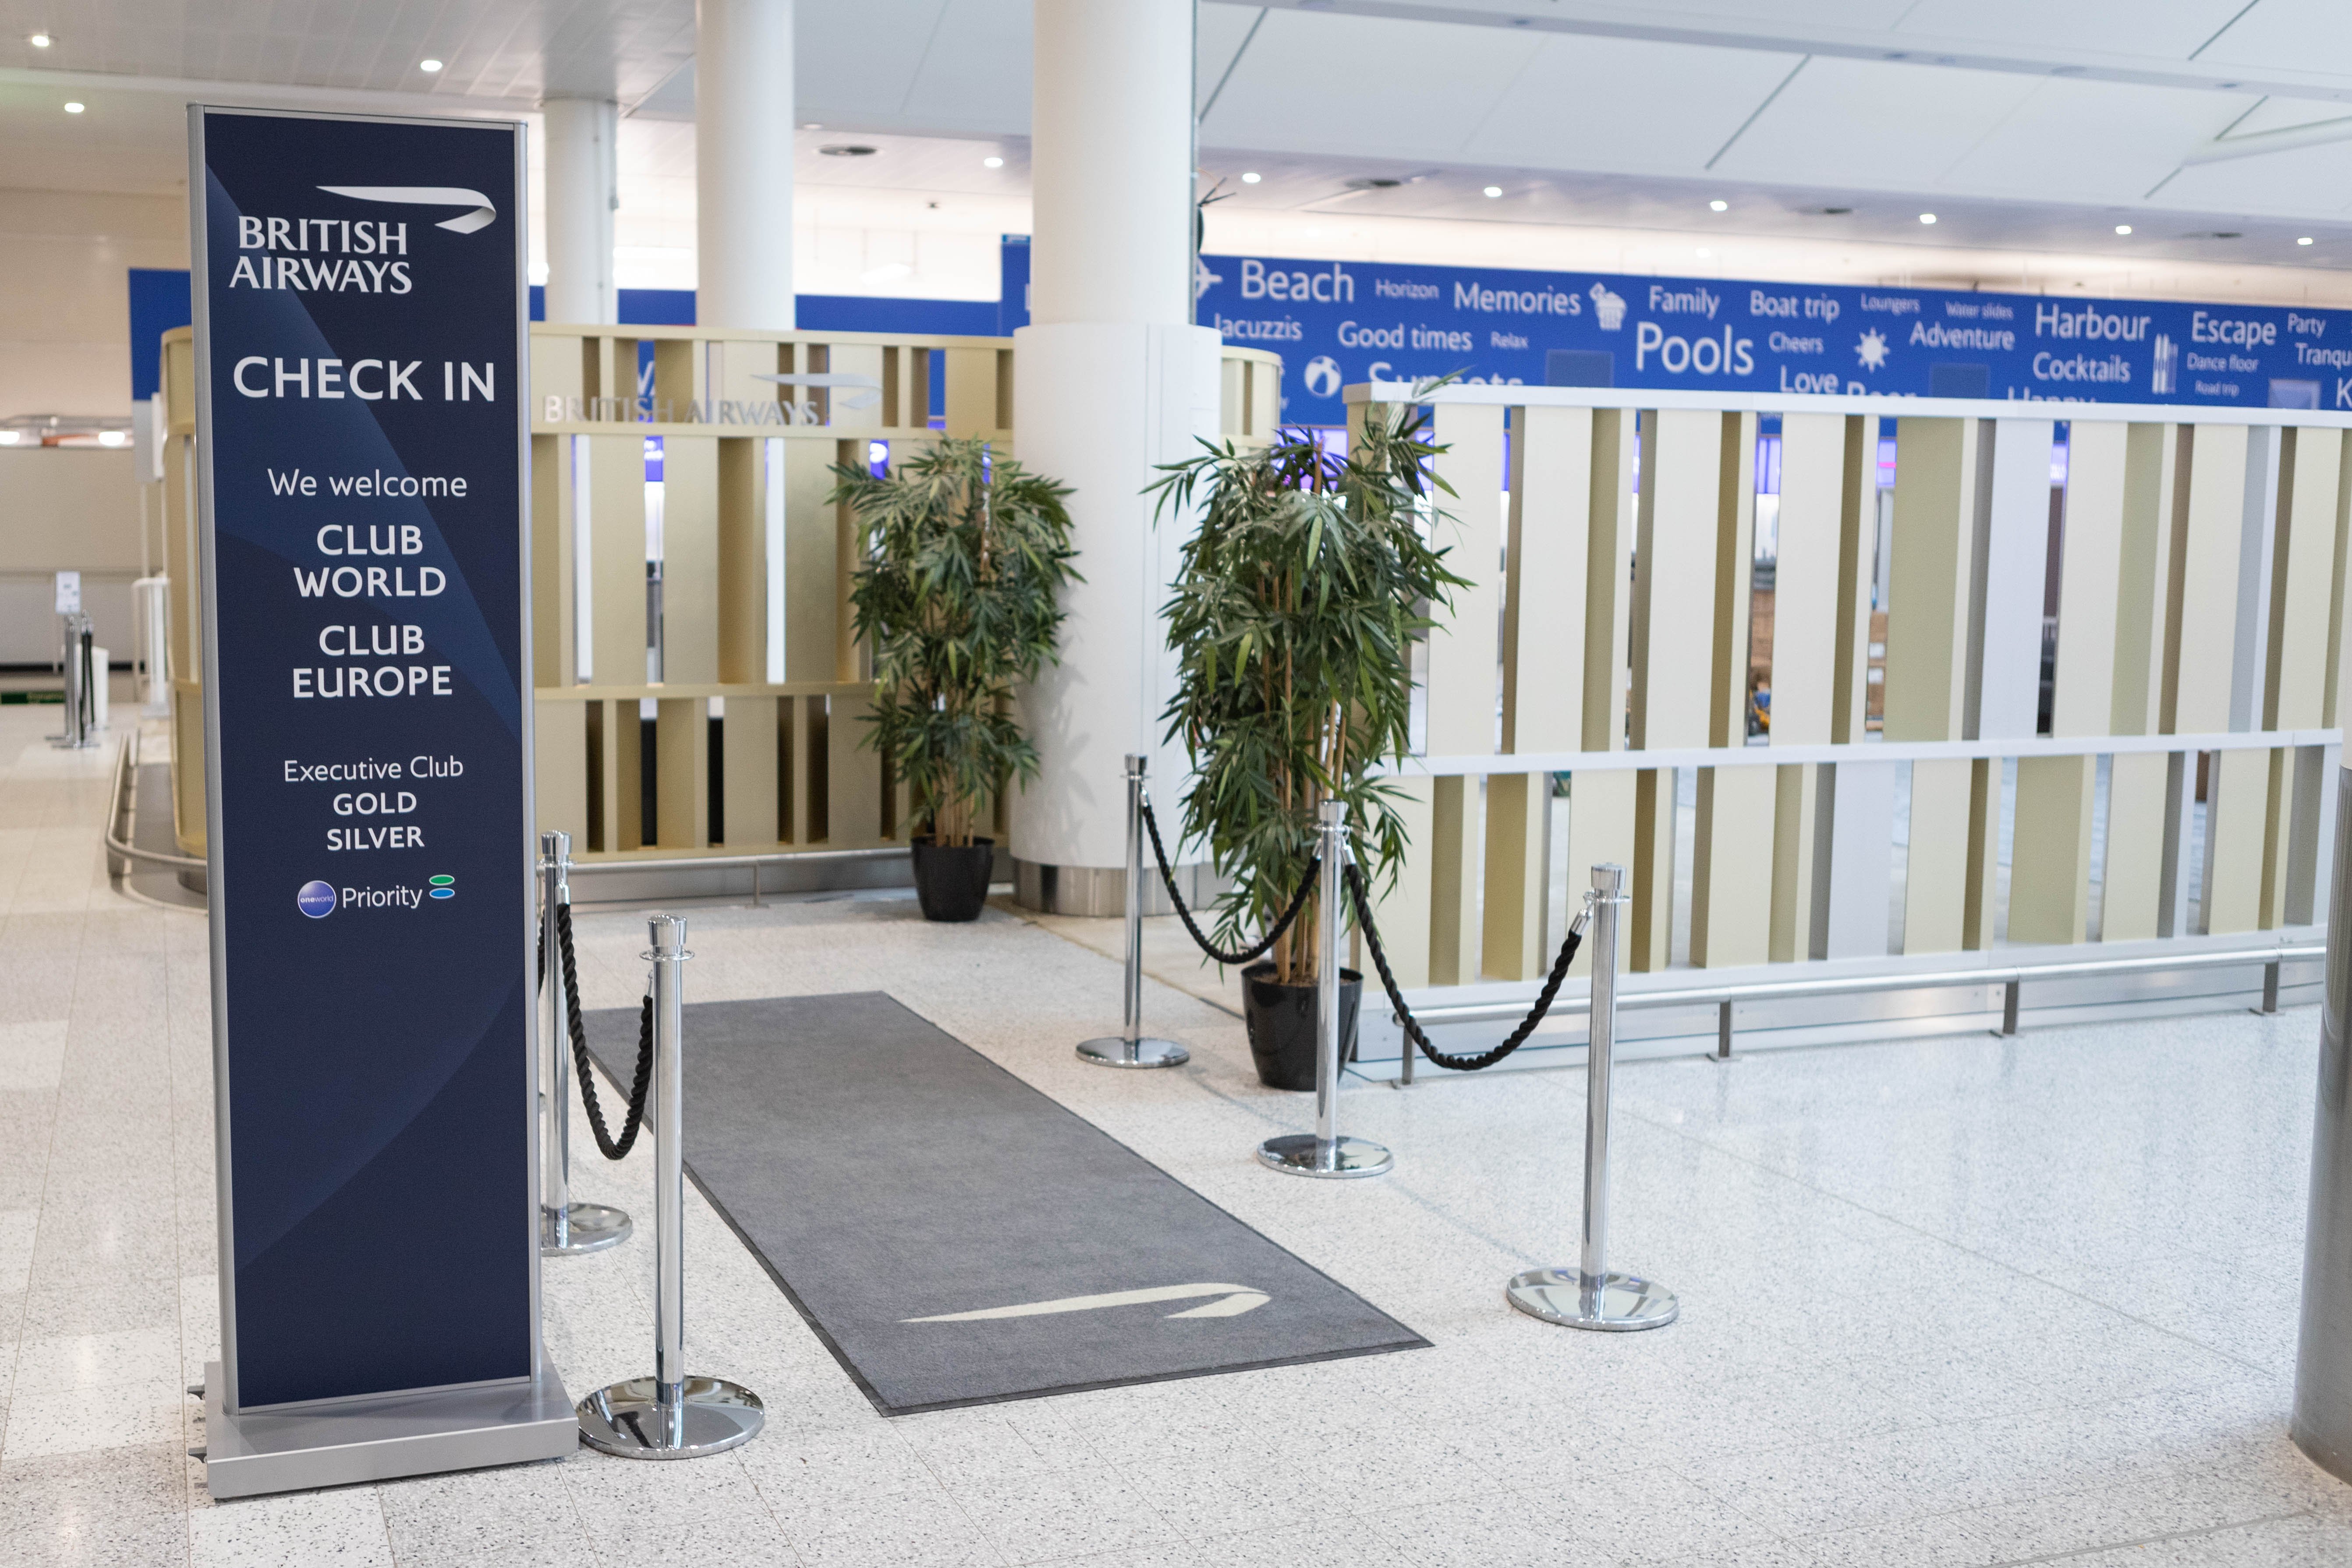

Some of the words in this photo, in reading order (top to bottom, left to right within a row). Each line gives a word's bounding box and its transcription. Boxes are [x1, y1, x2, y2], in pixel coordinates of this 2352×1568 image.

[238, 216, 407, 255] BRITISH
[229, 255, 412, 294] AIRWAYS
[1241, 259, 1354, 303] Beach
[1375, 279, 1439, 299] Horizon
[1453, 281, 1581, 316] Memories
[1649, 285, 1720, 320] Family
[1750, 290, 1799, 319] Boat
[1805, 293, 1840, 324] trip
[1860, 293, 1920, 316] Loungers
[1338, 320, 1404, 349] Good
[1411, 323, 1473, 351] times
[1909, 320, 2015, 350] Adventure
[2035, 302, 2152, 341] Harbour
[2192, 311, 2277, 349] Escape
[2287, 312, 2327, 339] Party
[1491, 331, 1529, 349] Relax
[1636, 321, 1754, 376] Pools
[1768, 331, 1824, 354] Cheers
[2032, 350, 2131, 383] Cocktails
[2187, 352, 2227, 372] Dance
[233, 356, 423, 401] CHECK
[444, 361, 495, 402] IN
[1780, 364, 1839, 394] Love
[543, 394, 673, 423] BRITISH
[684, 399, 820, 425] AIRWAYS
[268, 468, 317, 496] We
[329, 469, 468, 497] welcome
[316, 524, 423, 555] CLUB
[294, 566, 446, 598] WORLD
[319, 625, 425, 656] CLUB
[293, 665, 453, 698] EUROPE
[284, 757, 402, 782] Executive
[410, 755, 464, 778] Club
[333, 792, 417, 816] GOLD
[326, 826, 425, 851] SILVER
[300, 895, 334, 903] oneworld
[342, 885, 423, 909] Priority
